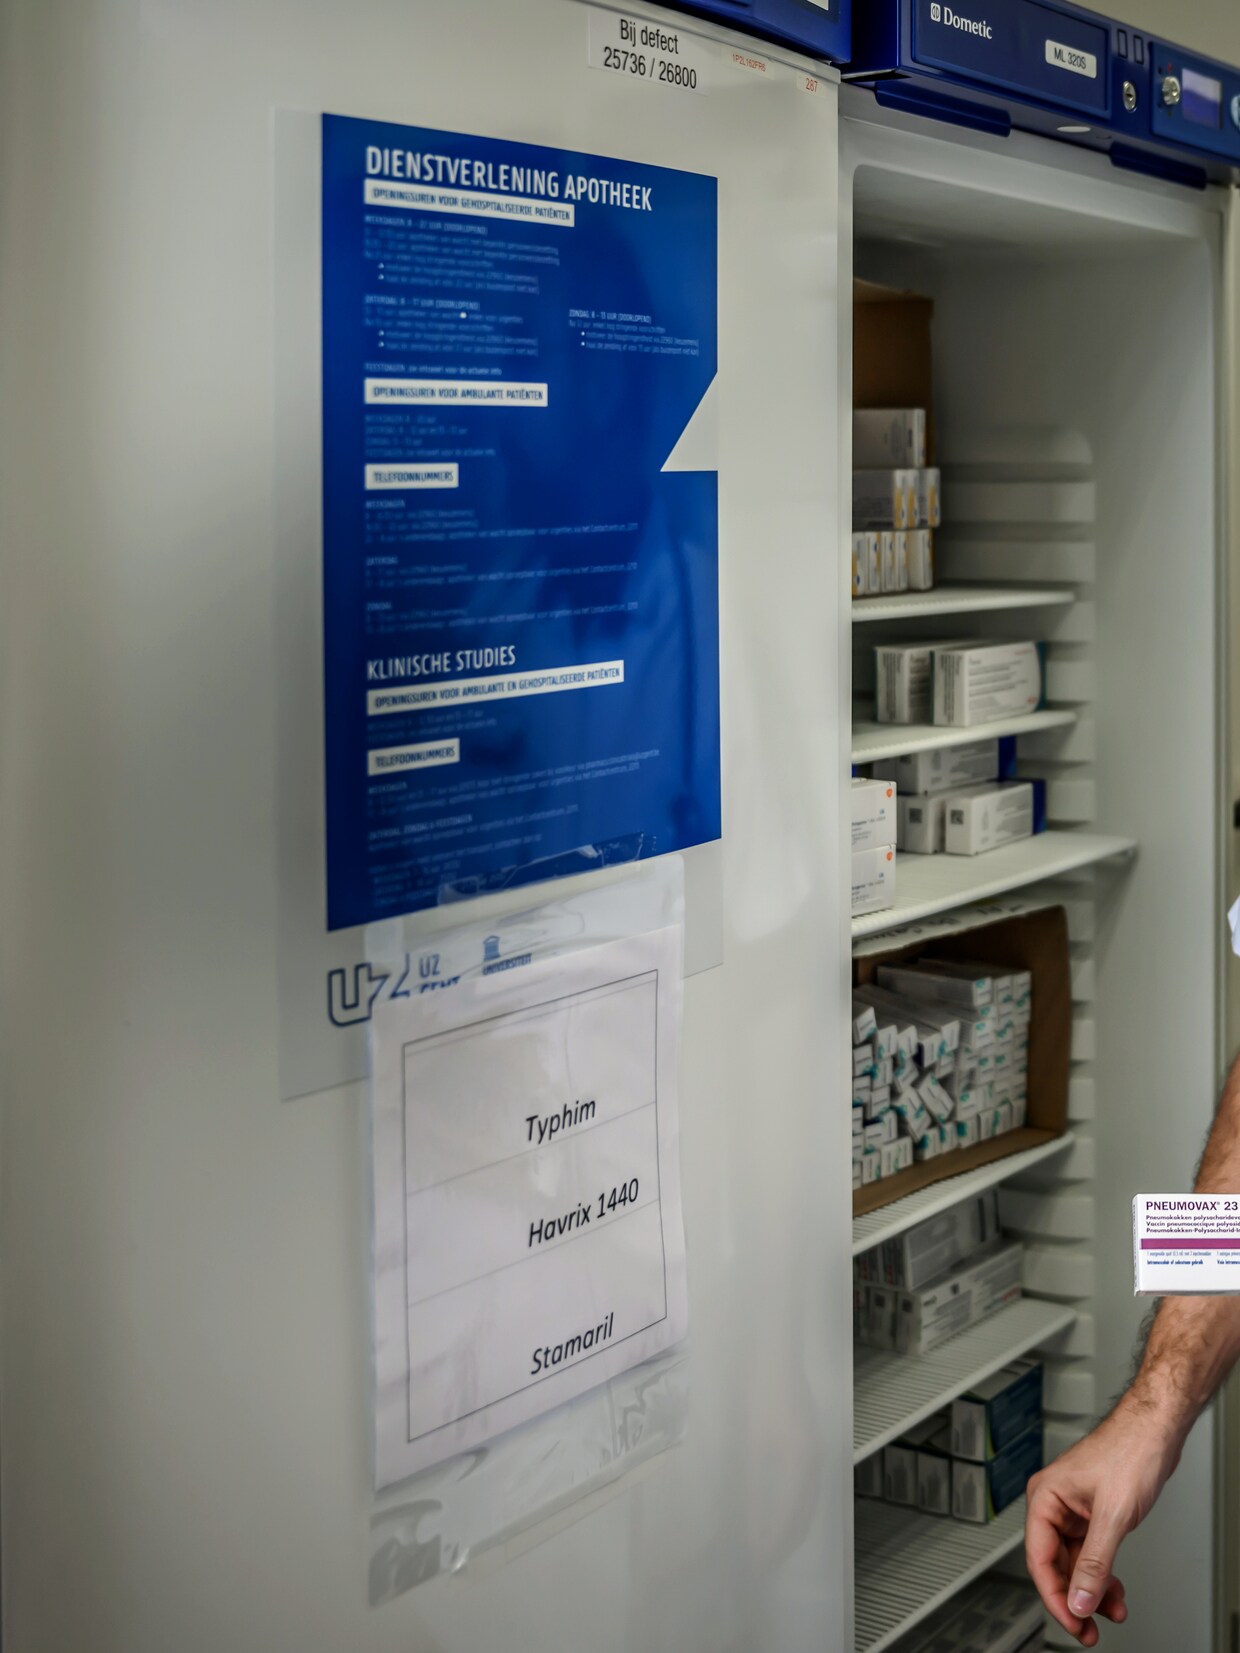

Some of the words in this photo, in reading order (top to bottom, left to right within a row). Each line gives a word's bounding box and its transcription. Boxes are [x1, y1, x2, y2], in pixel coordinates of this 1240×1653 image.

[620, 19, 636, 47] Bij
[641, 26, 679, 55] defect
[943, 7, 993, 40] Dometic
[604, 46, 646, 76] 25736
[659, 61, 697, 89] 26800
[1054, 47, 1066, 63] ML
[1068, 52, 1086, 70] 320S
[806, 78, 818, 92] 287
[366, 146, 560, 198] DIENSTVERLENING
[564, 175, 652, 211] APOTHEEK
[535, 206, 570, 220] PATIËNTEN
[461, 389, 504, 399] AMBULANTE
[506, 388, 543, 400] PATIËNTEN
[367, 652, 451, 681] KLINISCHE
[456, 645, 516, 671] STUDIES
[462, 682, 505, 697] AMBULANTE
[507, 682, 517, 691] EN
[587, 667, 620, 681] PATIËNTEN
[419, 954, 440, 978] UZ
[525, 1099, 596, 1145] Typhim
[529, 1202, 591, 1248] Havrix
[597, 1178, 639, 1219] 1440
[1224, 1201, 1238, 1211] 23
[530, 1311, 614, 1375] Stamaril
